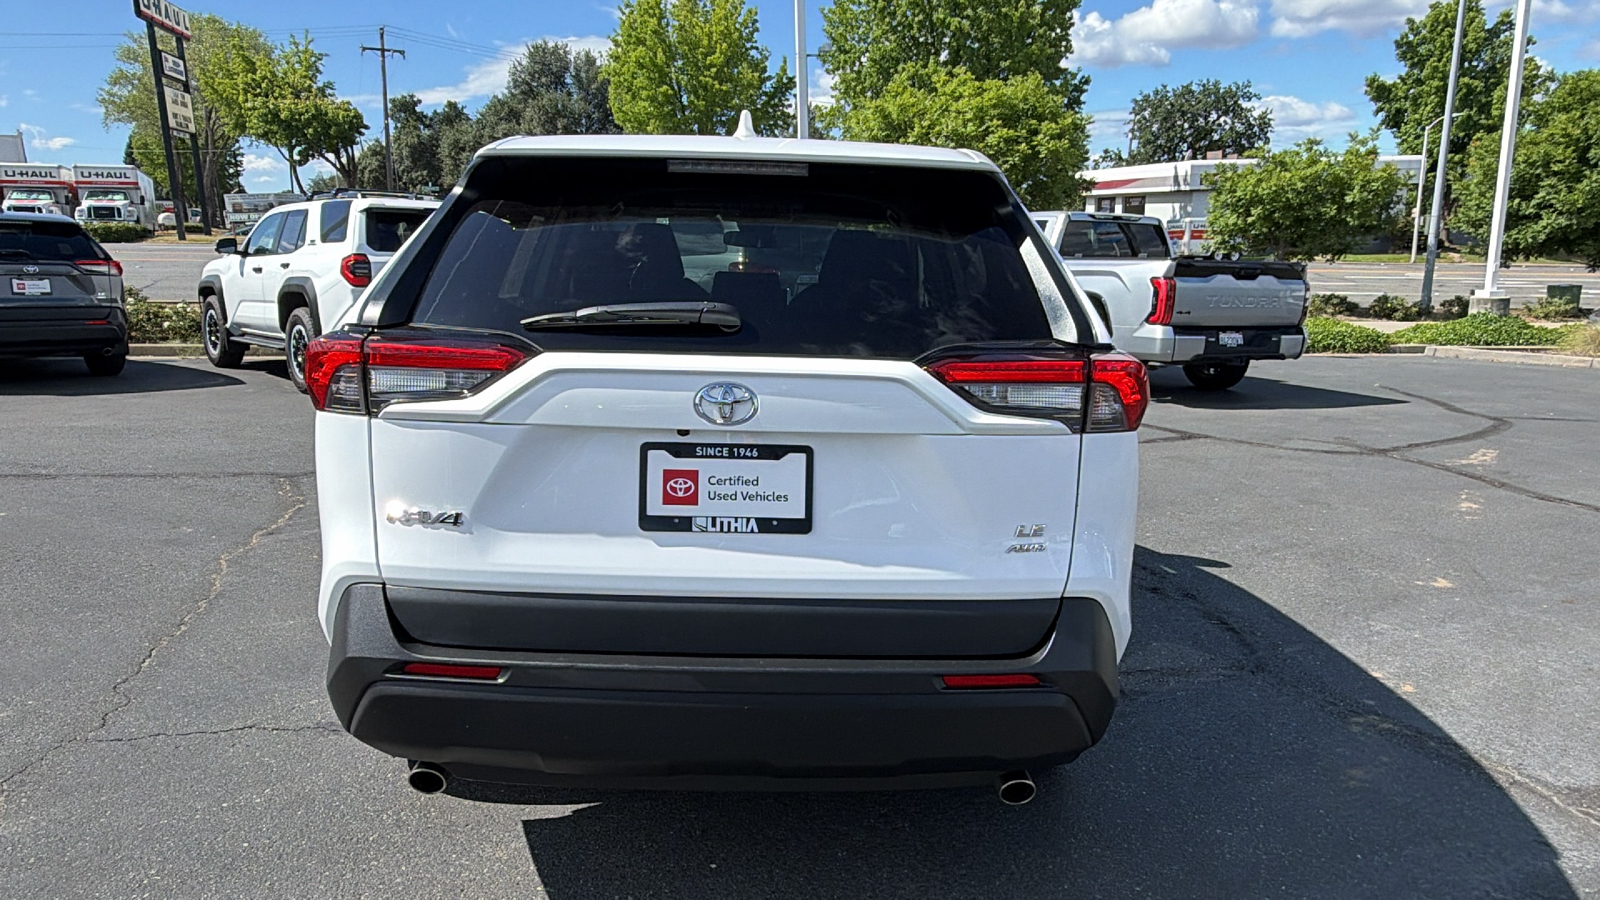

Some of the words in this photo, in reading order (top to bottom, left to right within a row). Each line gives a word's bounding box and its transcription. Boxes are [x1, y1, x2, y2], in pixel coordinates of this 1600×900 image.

[4, 169, 57, 178] U-HAUL
[81, 171, 131, 179] U-HAUL
[1206, 295, 1280, 308] TUNDRA
[696, 446, 729, 457] SINCE
[733, 448, 759, 457] 1946
[707, 475, 760, 487] Certified
[707, 490, 738, 501] Used
[740, 491, 789, 503] Vehicles
[387, 501, 464, 526] AV4
[707, 517, 759, 533] LITHIA
[1014, 524, 1047, 538] LE
